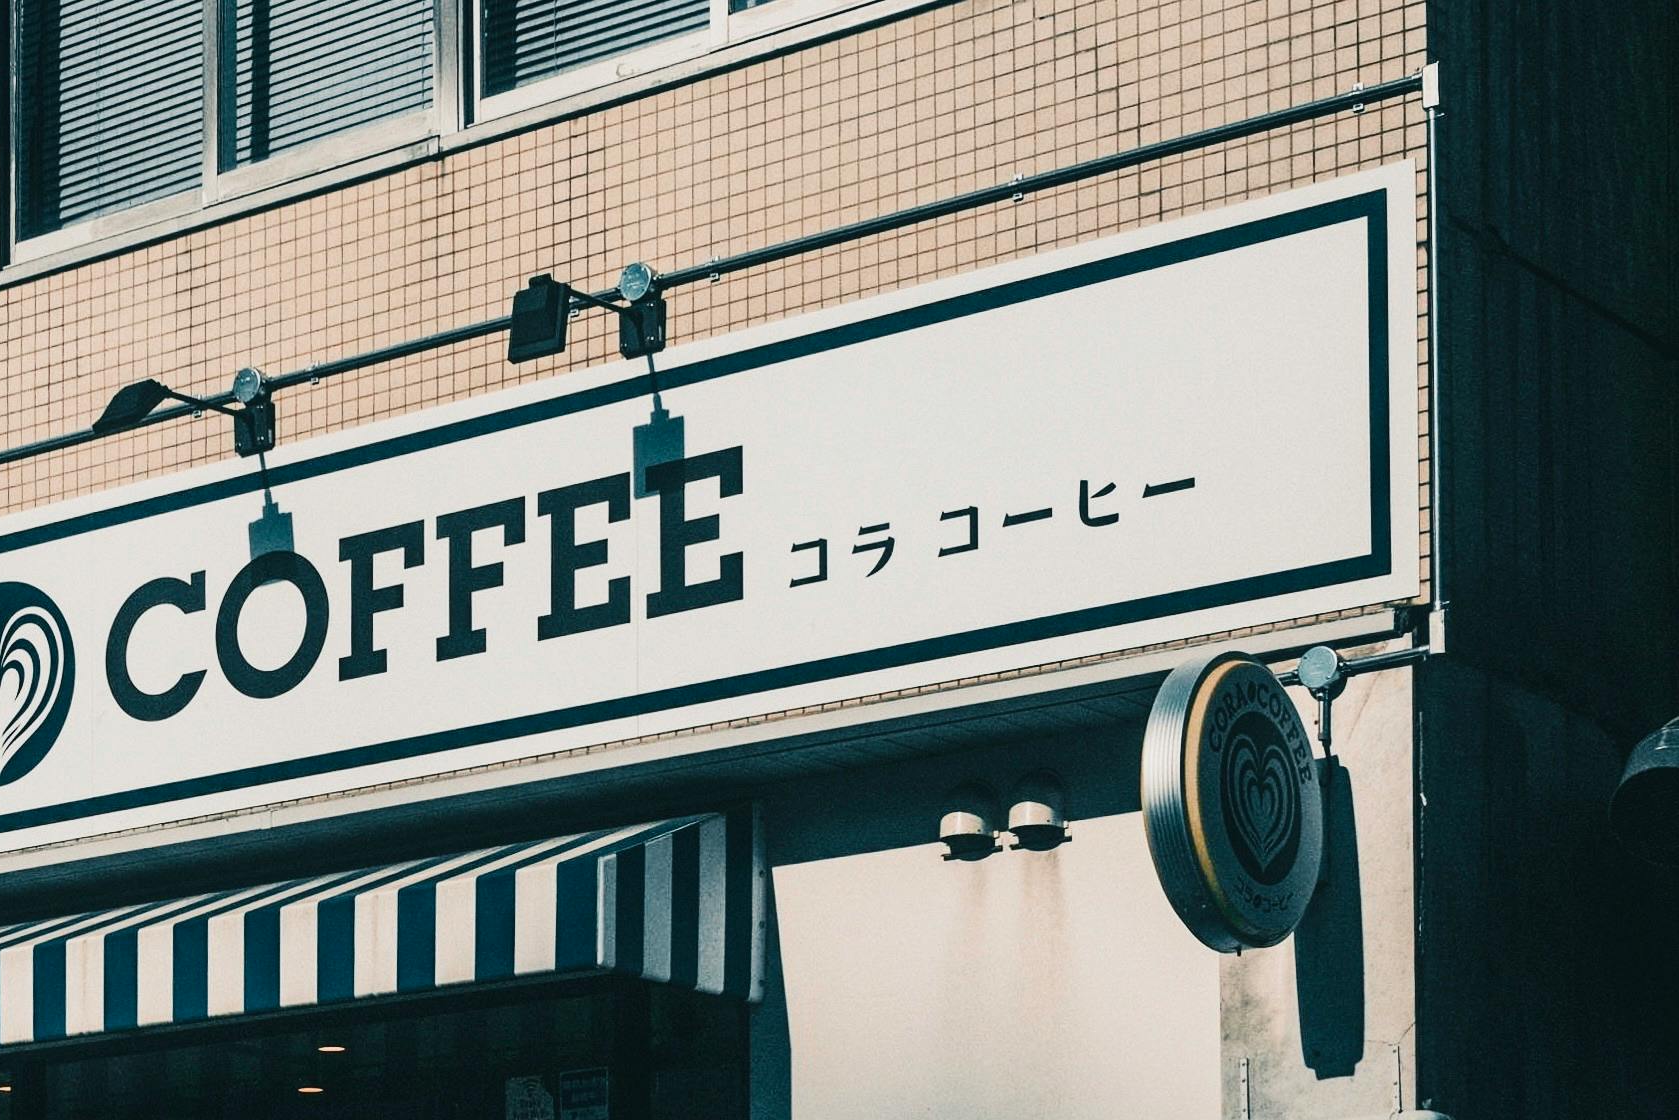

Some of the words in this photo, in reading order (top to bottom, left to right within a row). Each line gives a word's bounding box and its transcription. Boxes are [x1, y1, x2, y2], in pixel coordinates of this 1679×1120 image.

[106, 446, 743, 721] COFFEE
[790, 522, 895, 588] コラ
[938, 477, 1195, 558] コーヒー
[1209, 682, 1246, 752] CORA
